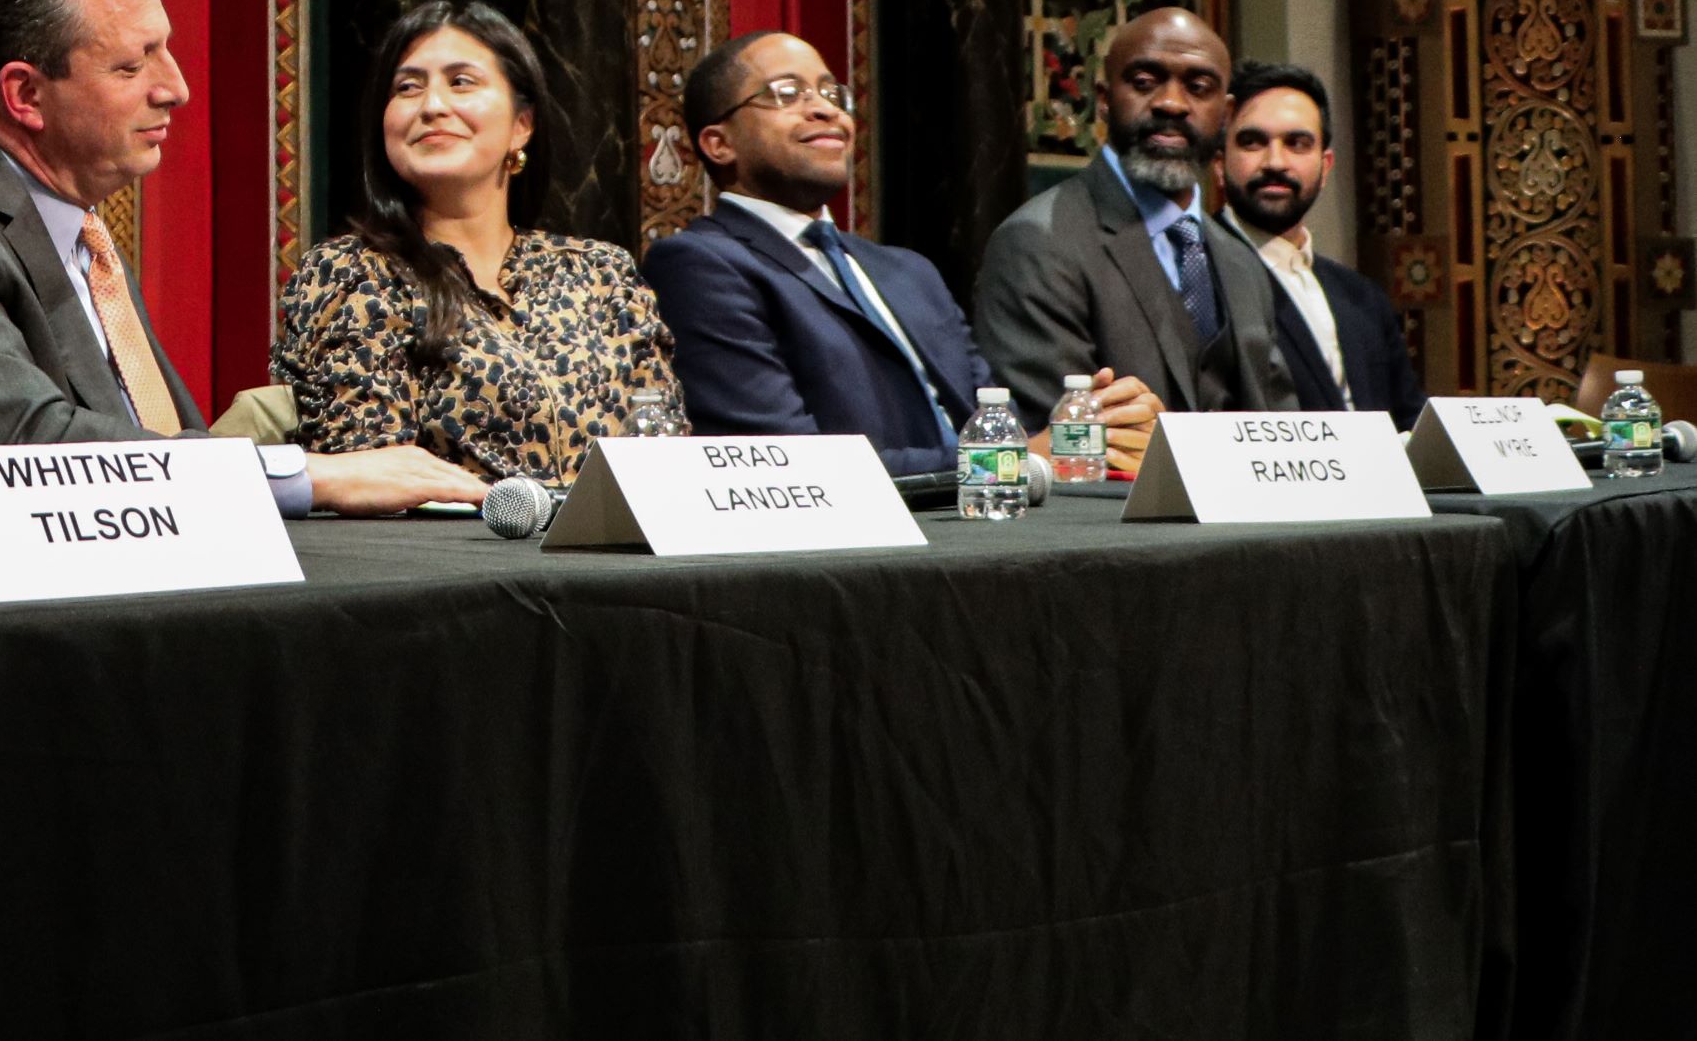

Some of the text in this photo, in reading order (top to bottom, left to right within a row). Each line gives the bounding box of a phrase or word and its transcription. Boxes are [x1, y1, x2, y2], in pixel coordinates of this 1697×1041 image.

[1234, 420, 1339, 443] JESSICA
[703, 445, 789, 468] BRAD
[1251, 459, 1346, 482] RAMOS
[705, 485, 833, 512] LANDER
[31, 506, 179, 544] TILSON
